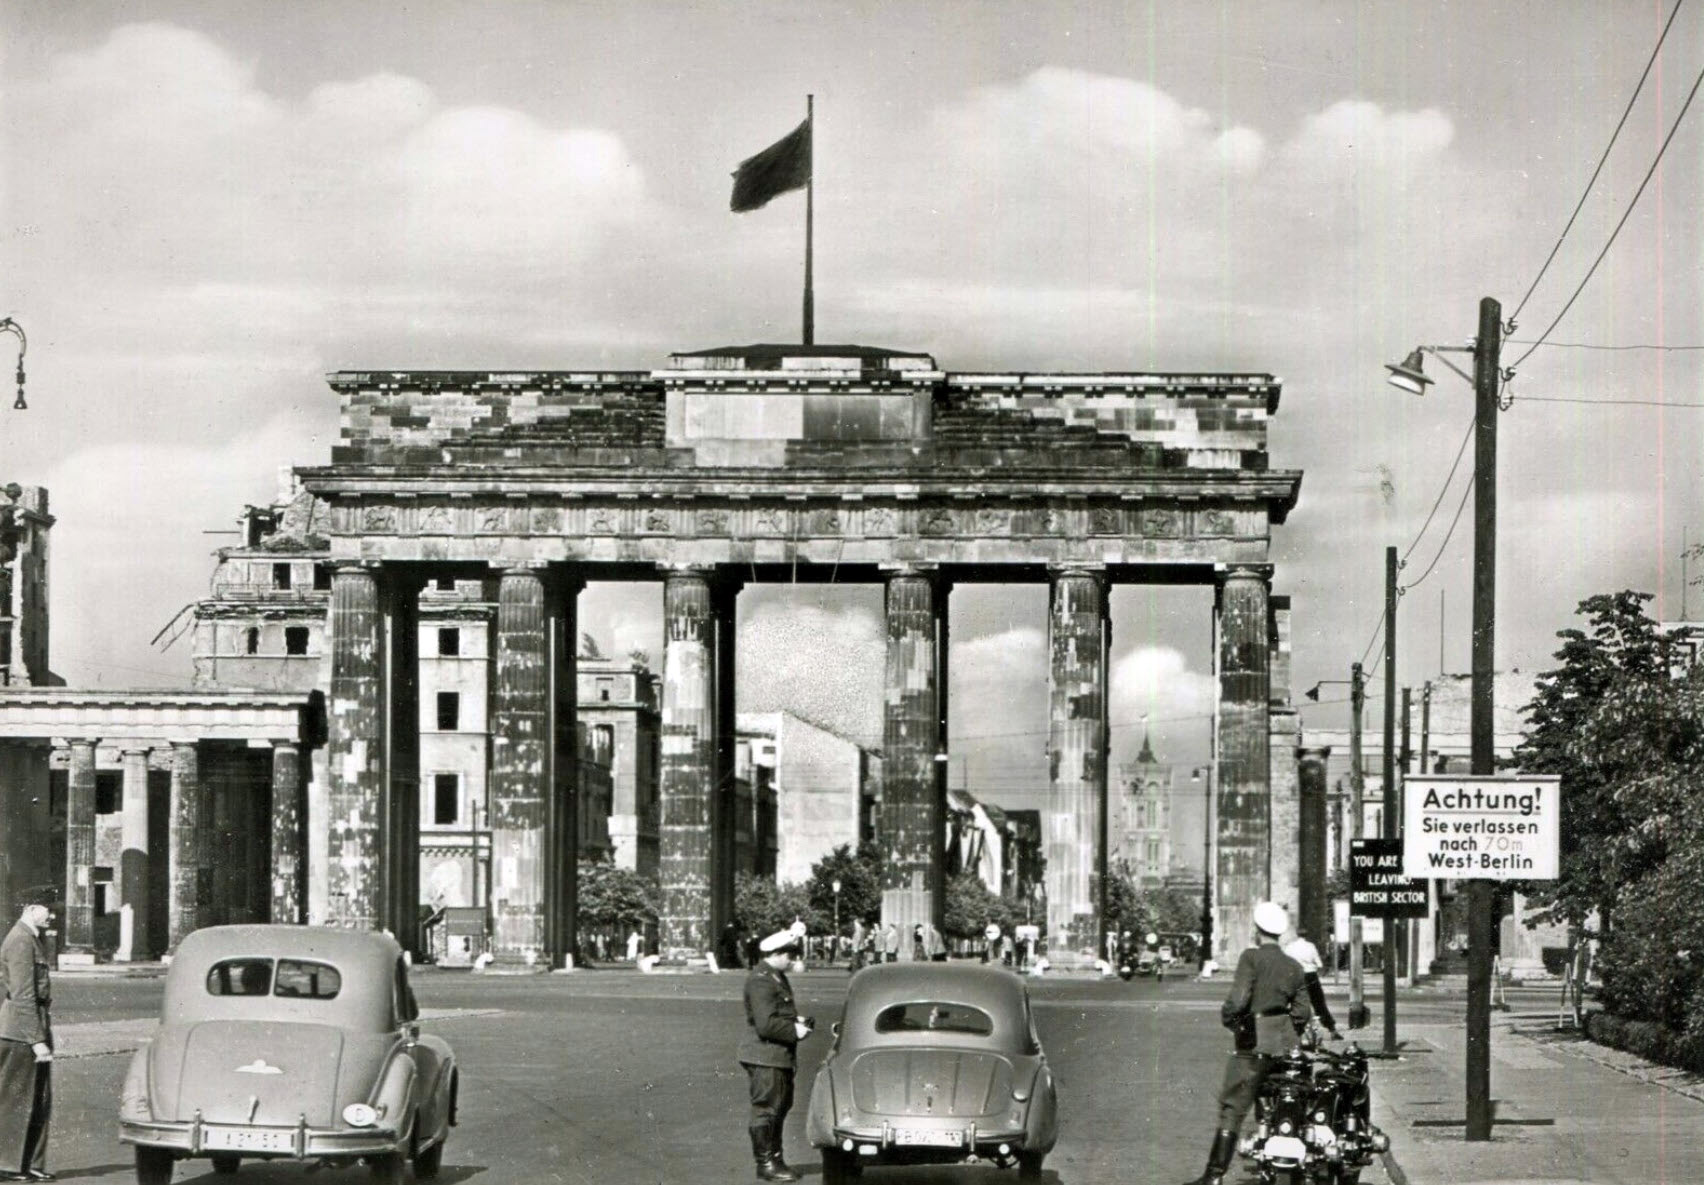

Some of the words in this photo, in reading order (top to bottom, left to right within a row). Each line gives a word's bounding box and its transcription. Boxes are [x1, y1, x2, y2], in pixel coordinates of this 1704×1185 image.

[1423, 787, 1541, 815] Achtung!
[1423, 817, 1448, 833] Sie
[1453, 818, 1538, 834] verlassen
[1440, 836, 1477, 851] nach
[1353, 855, 1373, 867] YOU
[1378, 855, 1398, 867] ARE
[1428, 852, 1533, 869] West-Berlin
[1353, 891, 1388, 903] BRITISH
[1391, 891, 1425, 903] SECTOR
